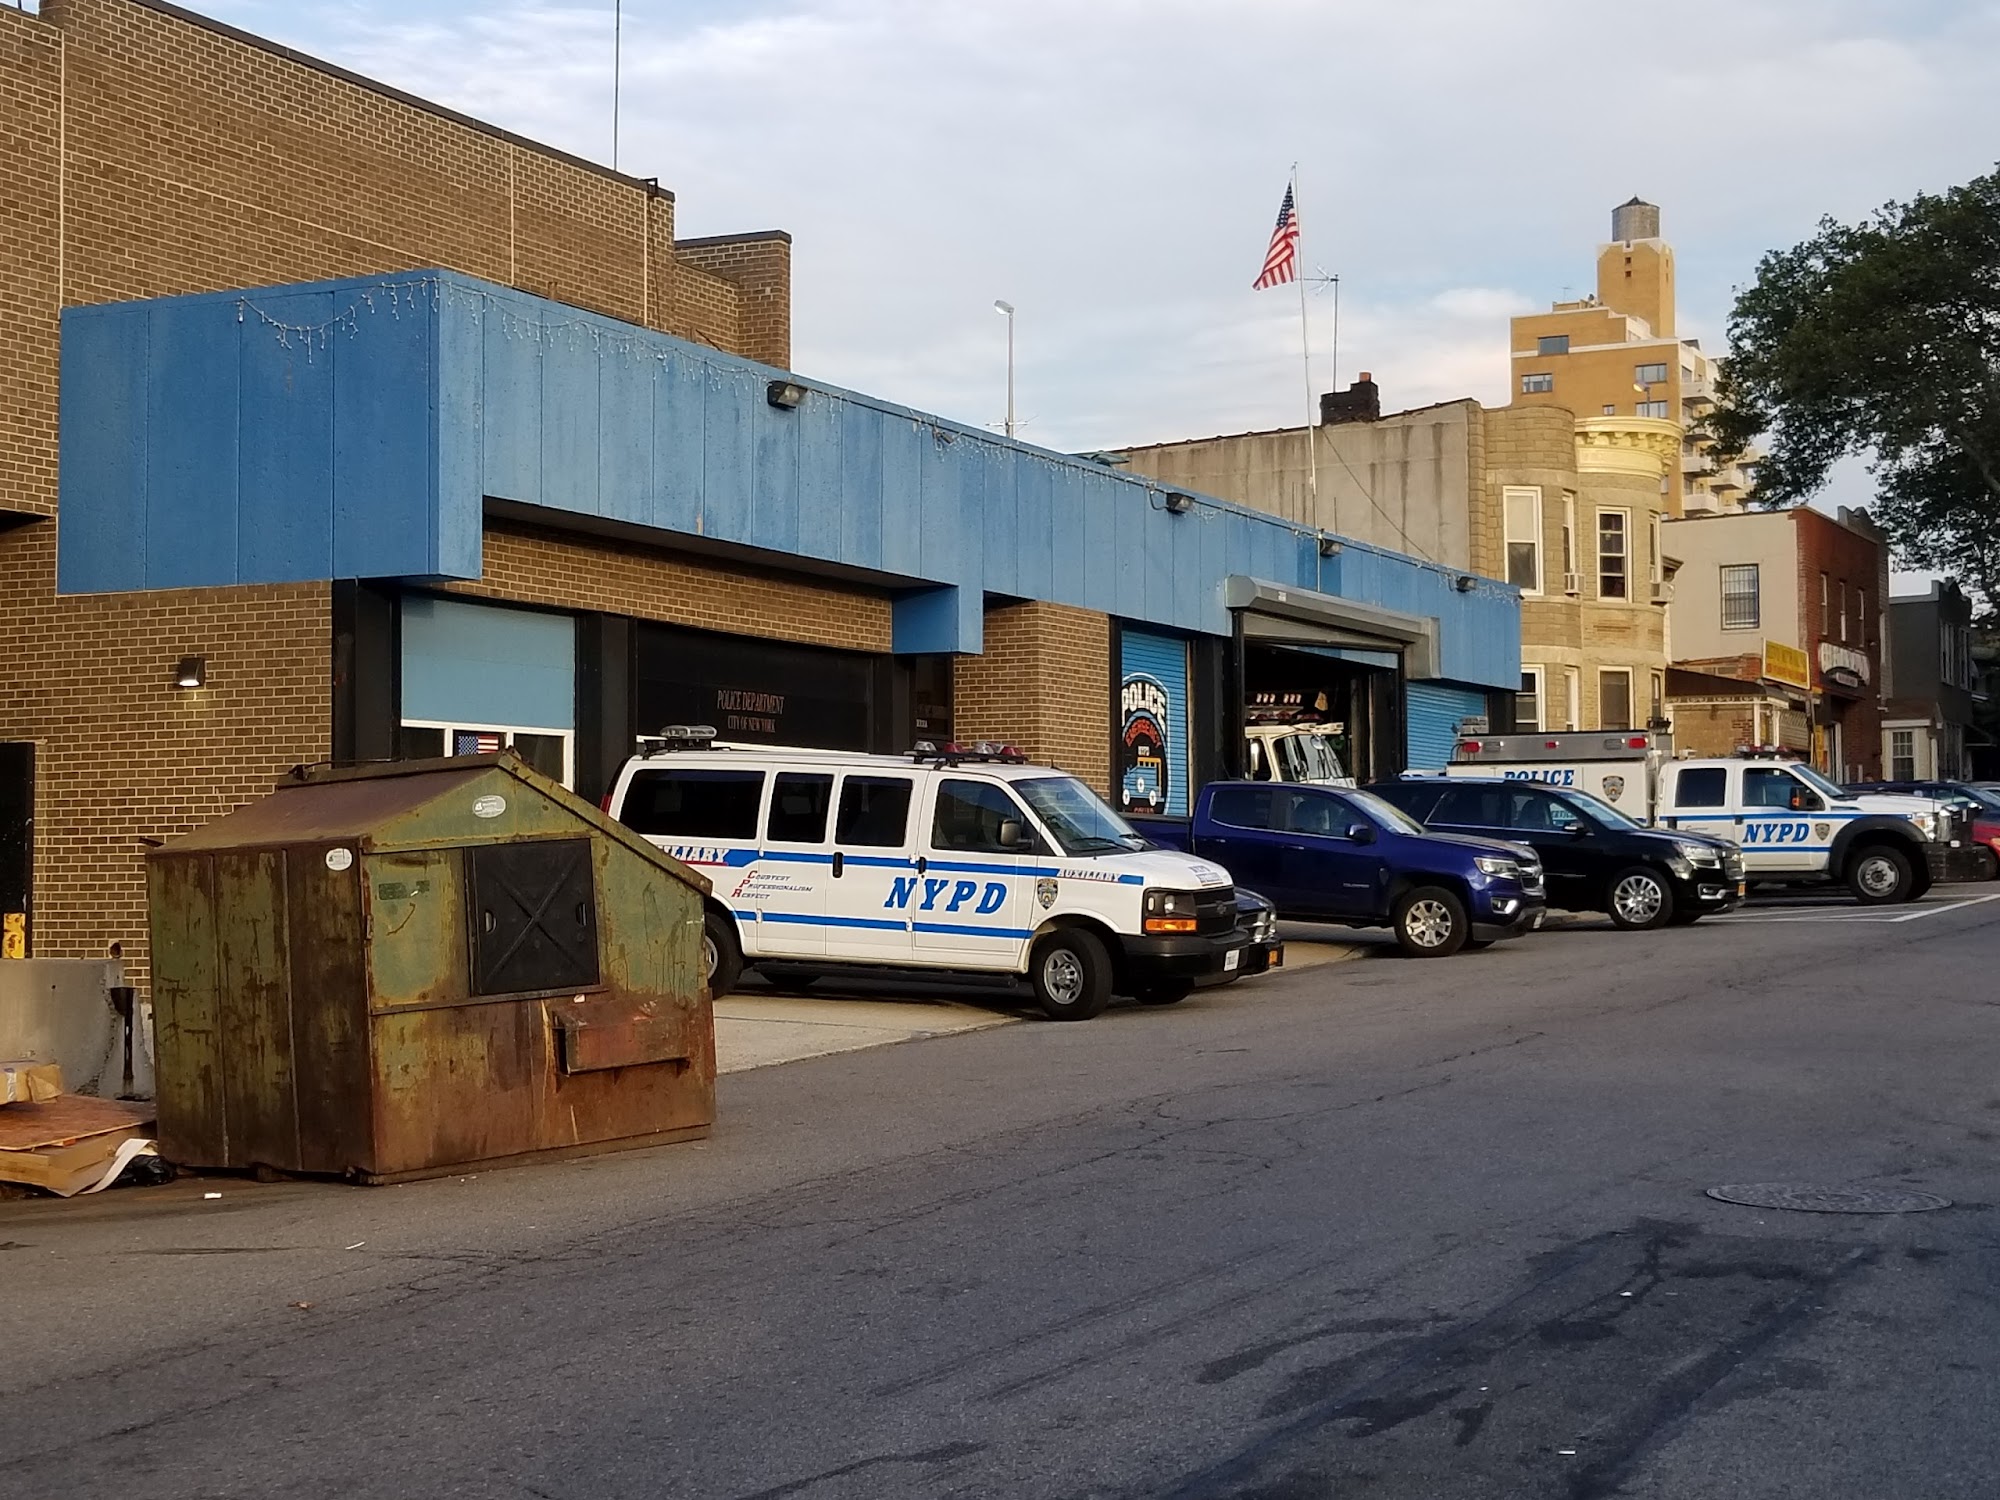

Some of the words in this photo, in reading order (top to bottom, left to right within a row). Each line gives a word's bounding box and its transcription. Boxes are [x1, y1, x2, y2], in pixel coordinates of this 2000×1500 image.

[717, 690, 741, 710] POLICE
[742, 692, 784, 714] DEPARTMENT
[1121, 682, 1166, 736] POLICE
[1742, 823, 1810, 843] NYPD
[1057, 869, 1121, 882] AUXILIARY
[883, 877, 1007, 914] NYPD
